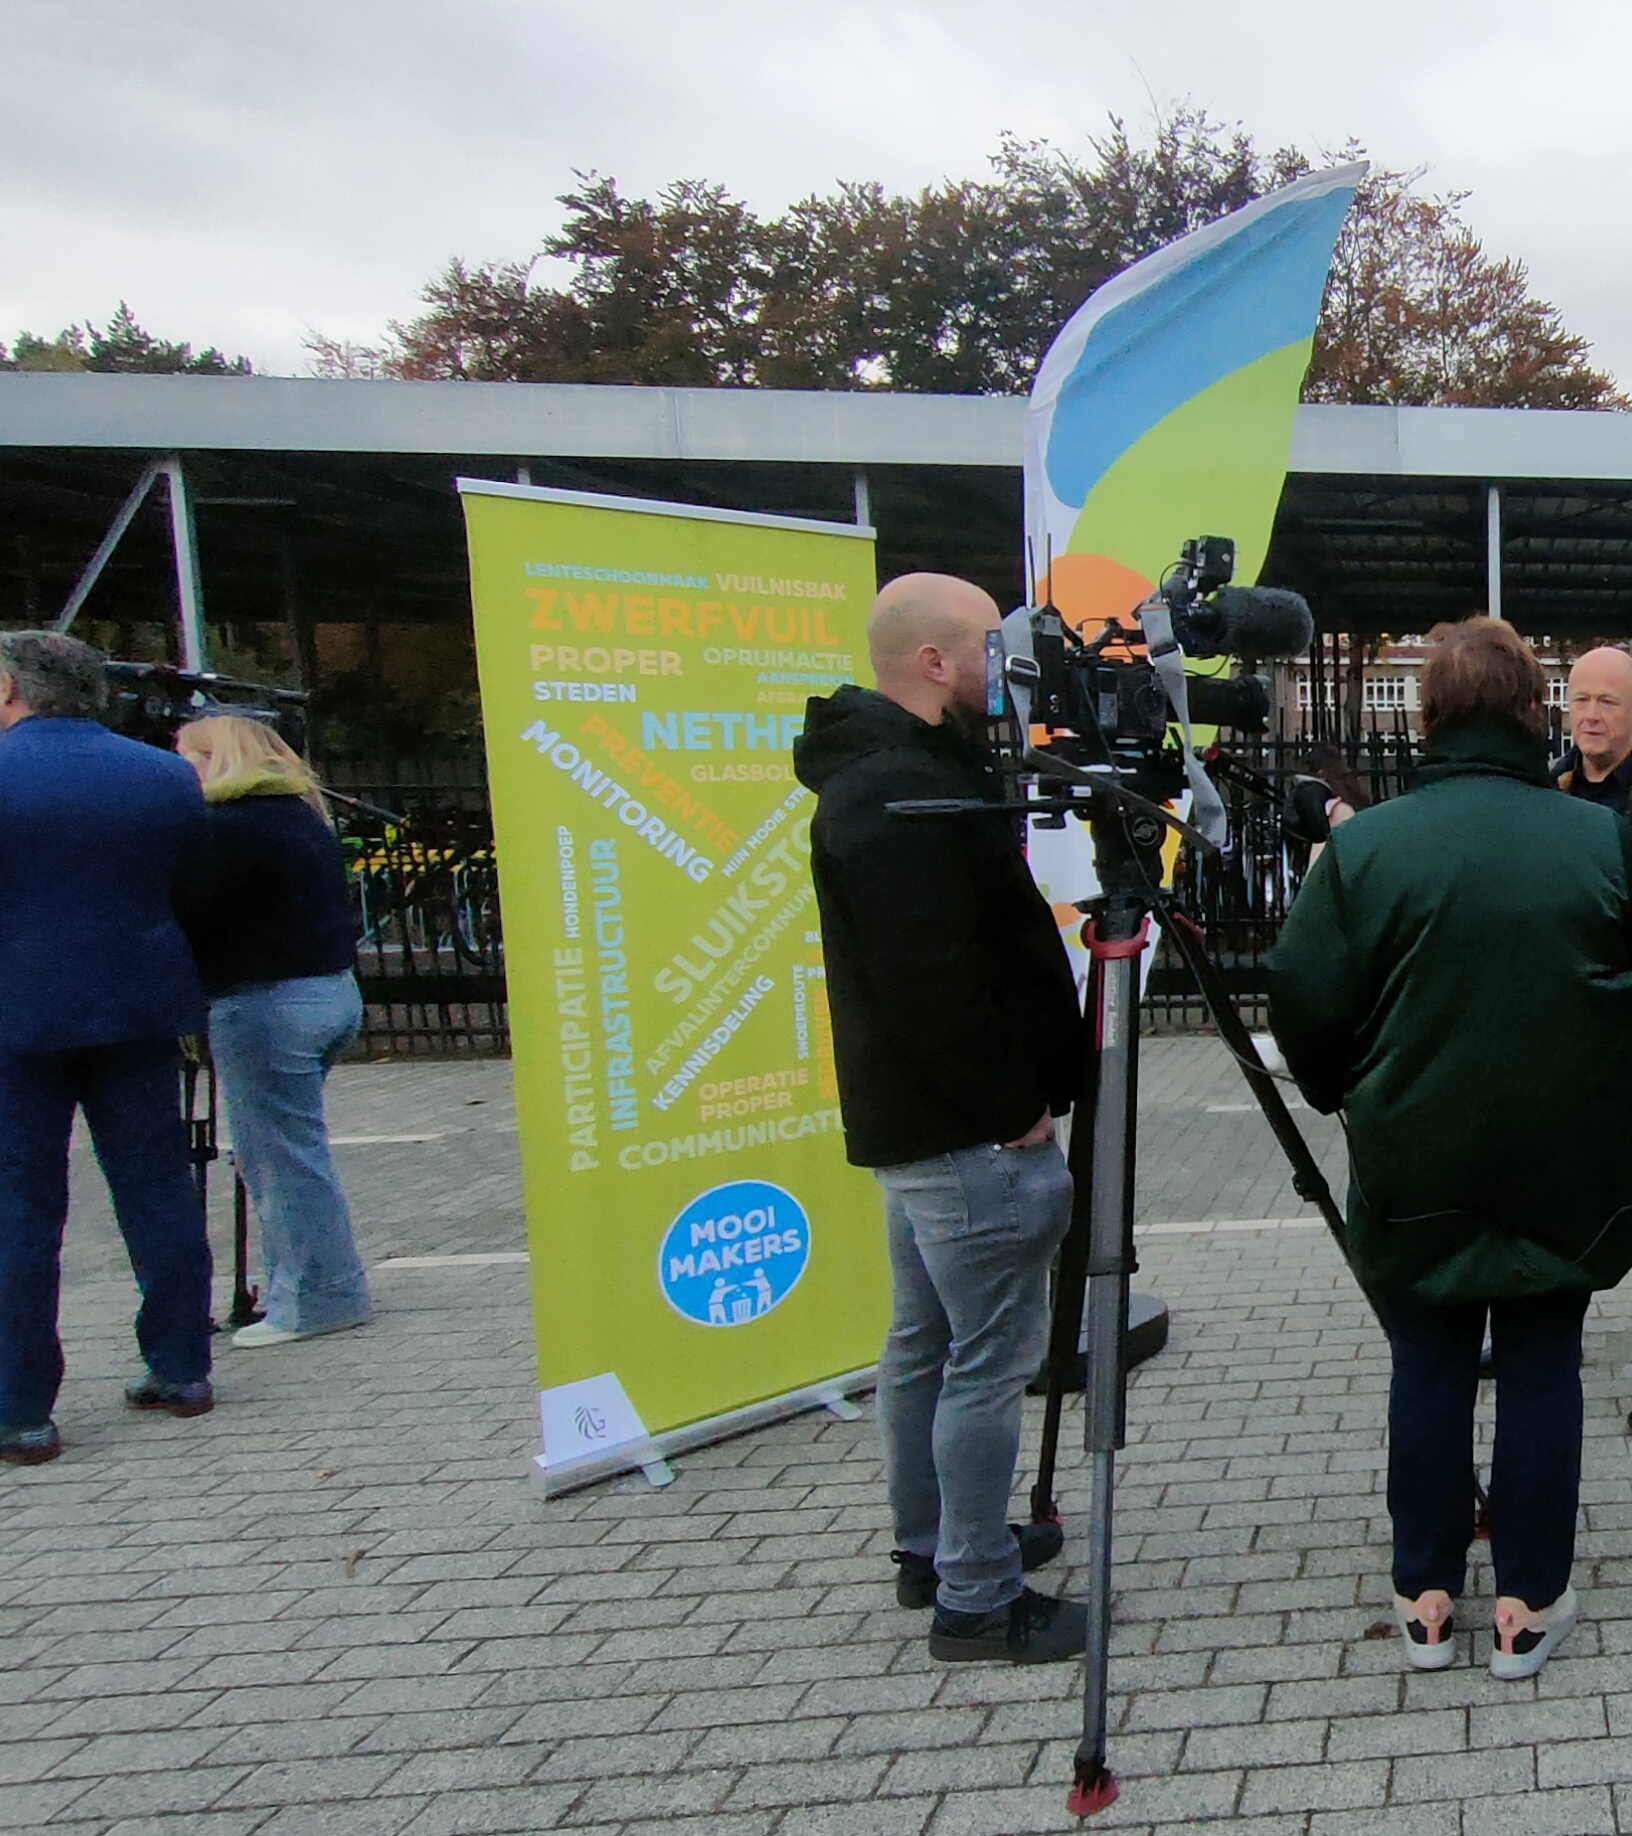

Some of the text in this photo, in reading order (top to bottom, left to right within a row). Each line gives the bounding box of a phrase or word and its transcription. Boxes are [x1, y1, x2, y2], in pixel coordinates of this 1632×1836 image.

[525, 562, 847, 601] LENTESCHOONMAAK VUILNISBAK
[525, 588, 840, 647] ZWERFVUIL
[530, 645, 683, 676] PROPER
[703, 647, 853, 672] OPRUIMACTIE
[533, 681, 636, 702] STEDEN
[520, 719, 714, 883] MONITORING
[579, 713, 738, 855] PREVENTIE
[746, 808, 786, 849] MOOIE
[556, 825, 580, 938] HONDENPOEP
[590, 838, 638, 1131] INFRASTRUCTUUR
[554, 947, 599, 1172] PARTICIPATIE
[651, 974, 775, 1112] KENNISDELING
[699, 1067, 809, 1102] OPERATIE
[700, 1091, 794, 1122] PROPER
[618, 1106, 846, 1171] COMMUNICATI
[690, 1205, 776, 1248] MOOI
[669, 1228, 803, 1283] MAKERS
